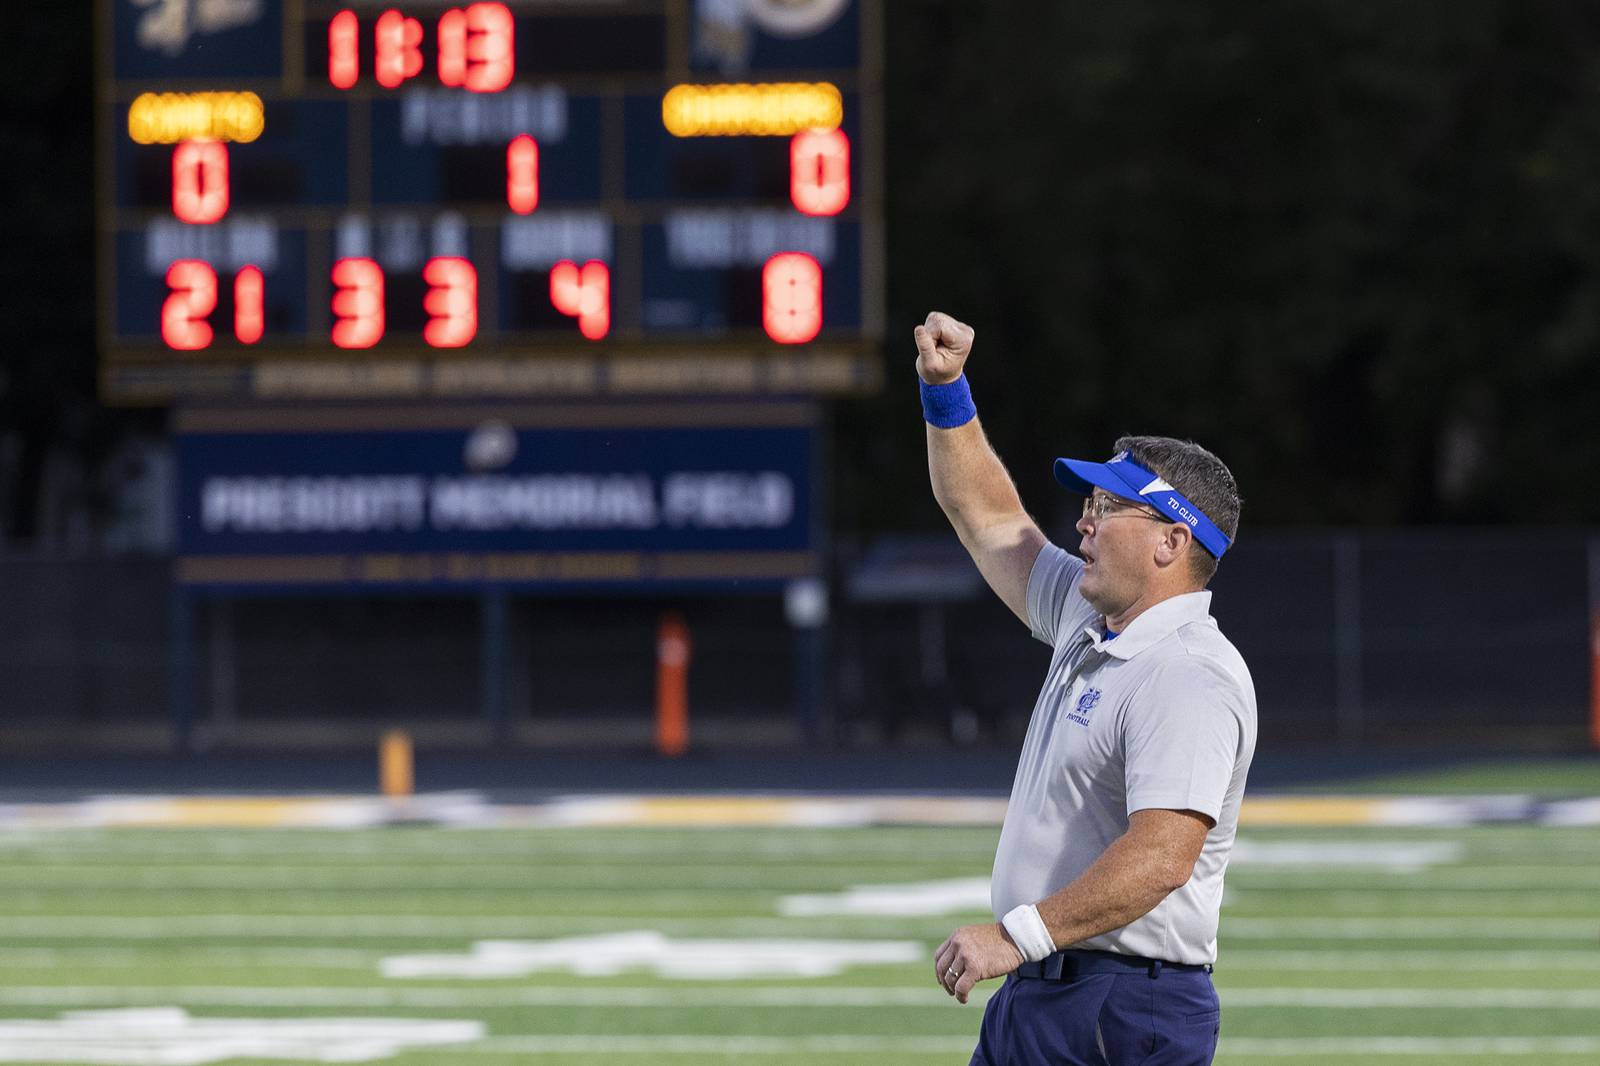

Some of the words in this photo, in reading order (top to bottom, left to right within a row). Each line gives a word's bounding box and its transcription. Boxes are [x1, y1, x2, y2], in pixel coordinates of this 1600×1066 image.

[172, 139, 229, 224] 0
[507, 133, 539, 215] 1
[789, 127, 851, 216] 0
[161, 258, 265, 351] 21
[550, 259, 610, 340] 4
[762, 251, 823, 344] 8
[661, 471, 794, 529] FIELD
[1168, 497, 1180, 510] TD
[1178, 507, 1199, 527] CLUB
[1066, 712, 1090, 727] FOOTBALL
